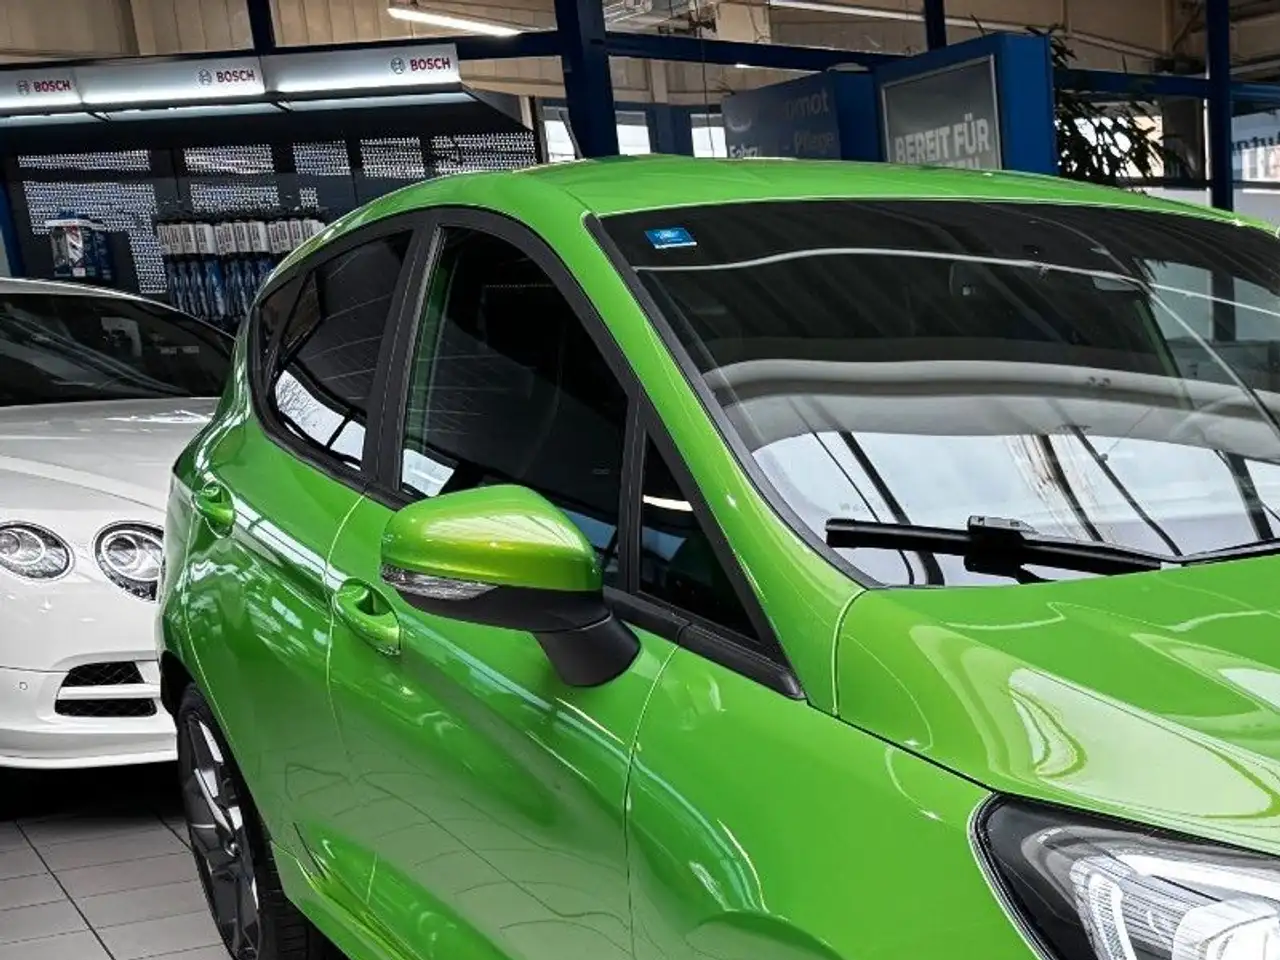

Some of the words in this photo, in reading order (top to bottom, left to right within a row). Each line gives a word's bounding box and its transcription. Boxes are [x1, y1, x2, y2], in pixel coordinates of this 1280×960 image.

[409, 57, 451, 72] BOSCH
[215, 70, 256, 83] BOSCH
[33, 79, 72, 93] BOSCH
[894, 126, 951, 163] BEREIT
[953, 112, 990, 157] FÜR
